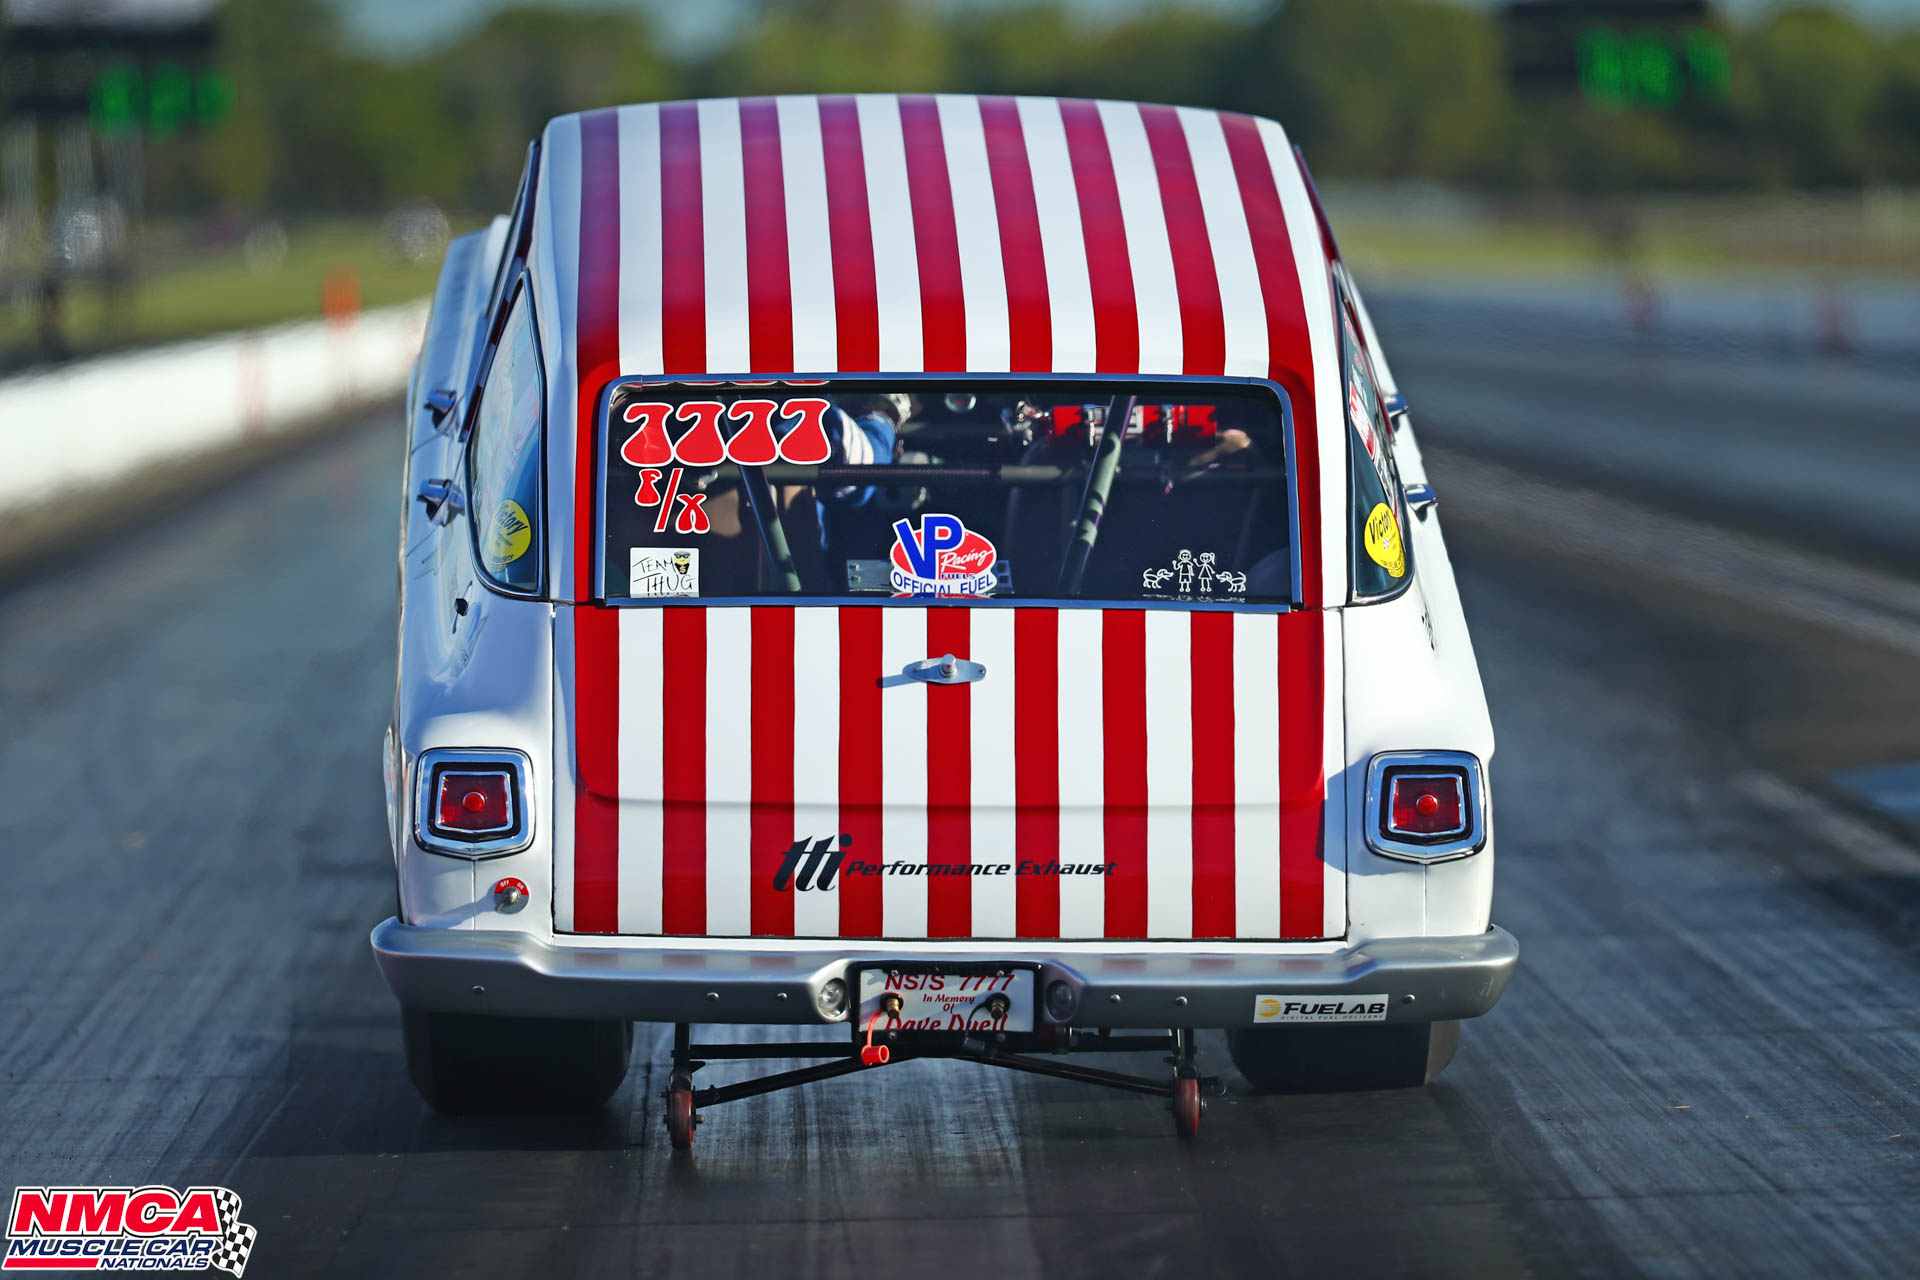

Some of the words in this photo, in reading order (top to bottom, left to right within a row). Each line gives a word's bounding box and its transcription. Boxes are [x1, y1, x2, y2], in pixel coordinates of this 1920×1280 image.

[621, 398, 831, 466] 7777
[893, 514, 965, 580] VP
[632, 556, 676, 573] TEAM
[941, 548, 994, 572] Racing
[633, 573, 697, 594] THUG
[893, 571, 951, 593] OFFICIAL
[960, 574, 994, 594] FUEL
[772, 833, 853, 891] tti
[845, 860, 1011, 876] Performance
[1015, 860, 1119, 876] Exhaust
[884, 974, 945, 991] NS/S
[959, 974, 1015, 991] 7777
[922, 994, 933, 1003] In
[935, 994, 976, 1004] Memory
[1283, 1002, 1385, 1015] FUELAB
